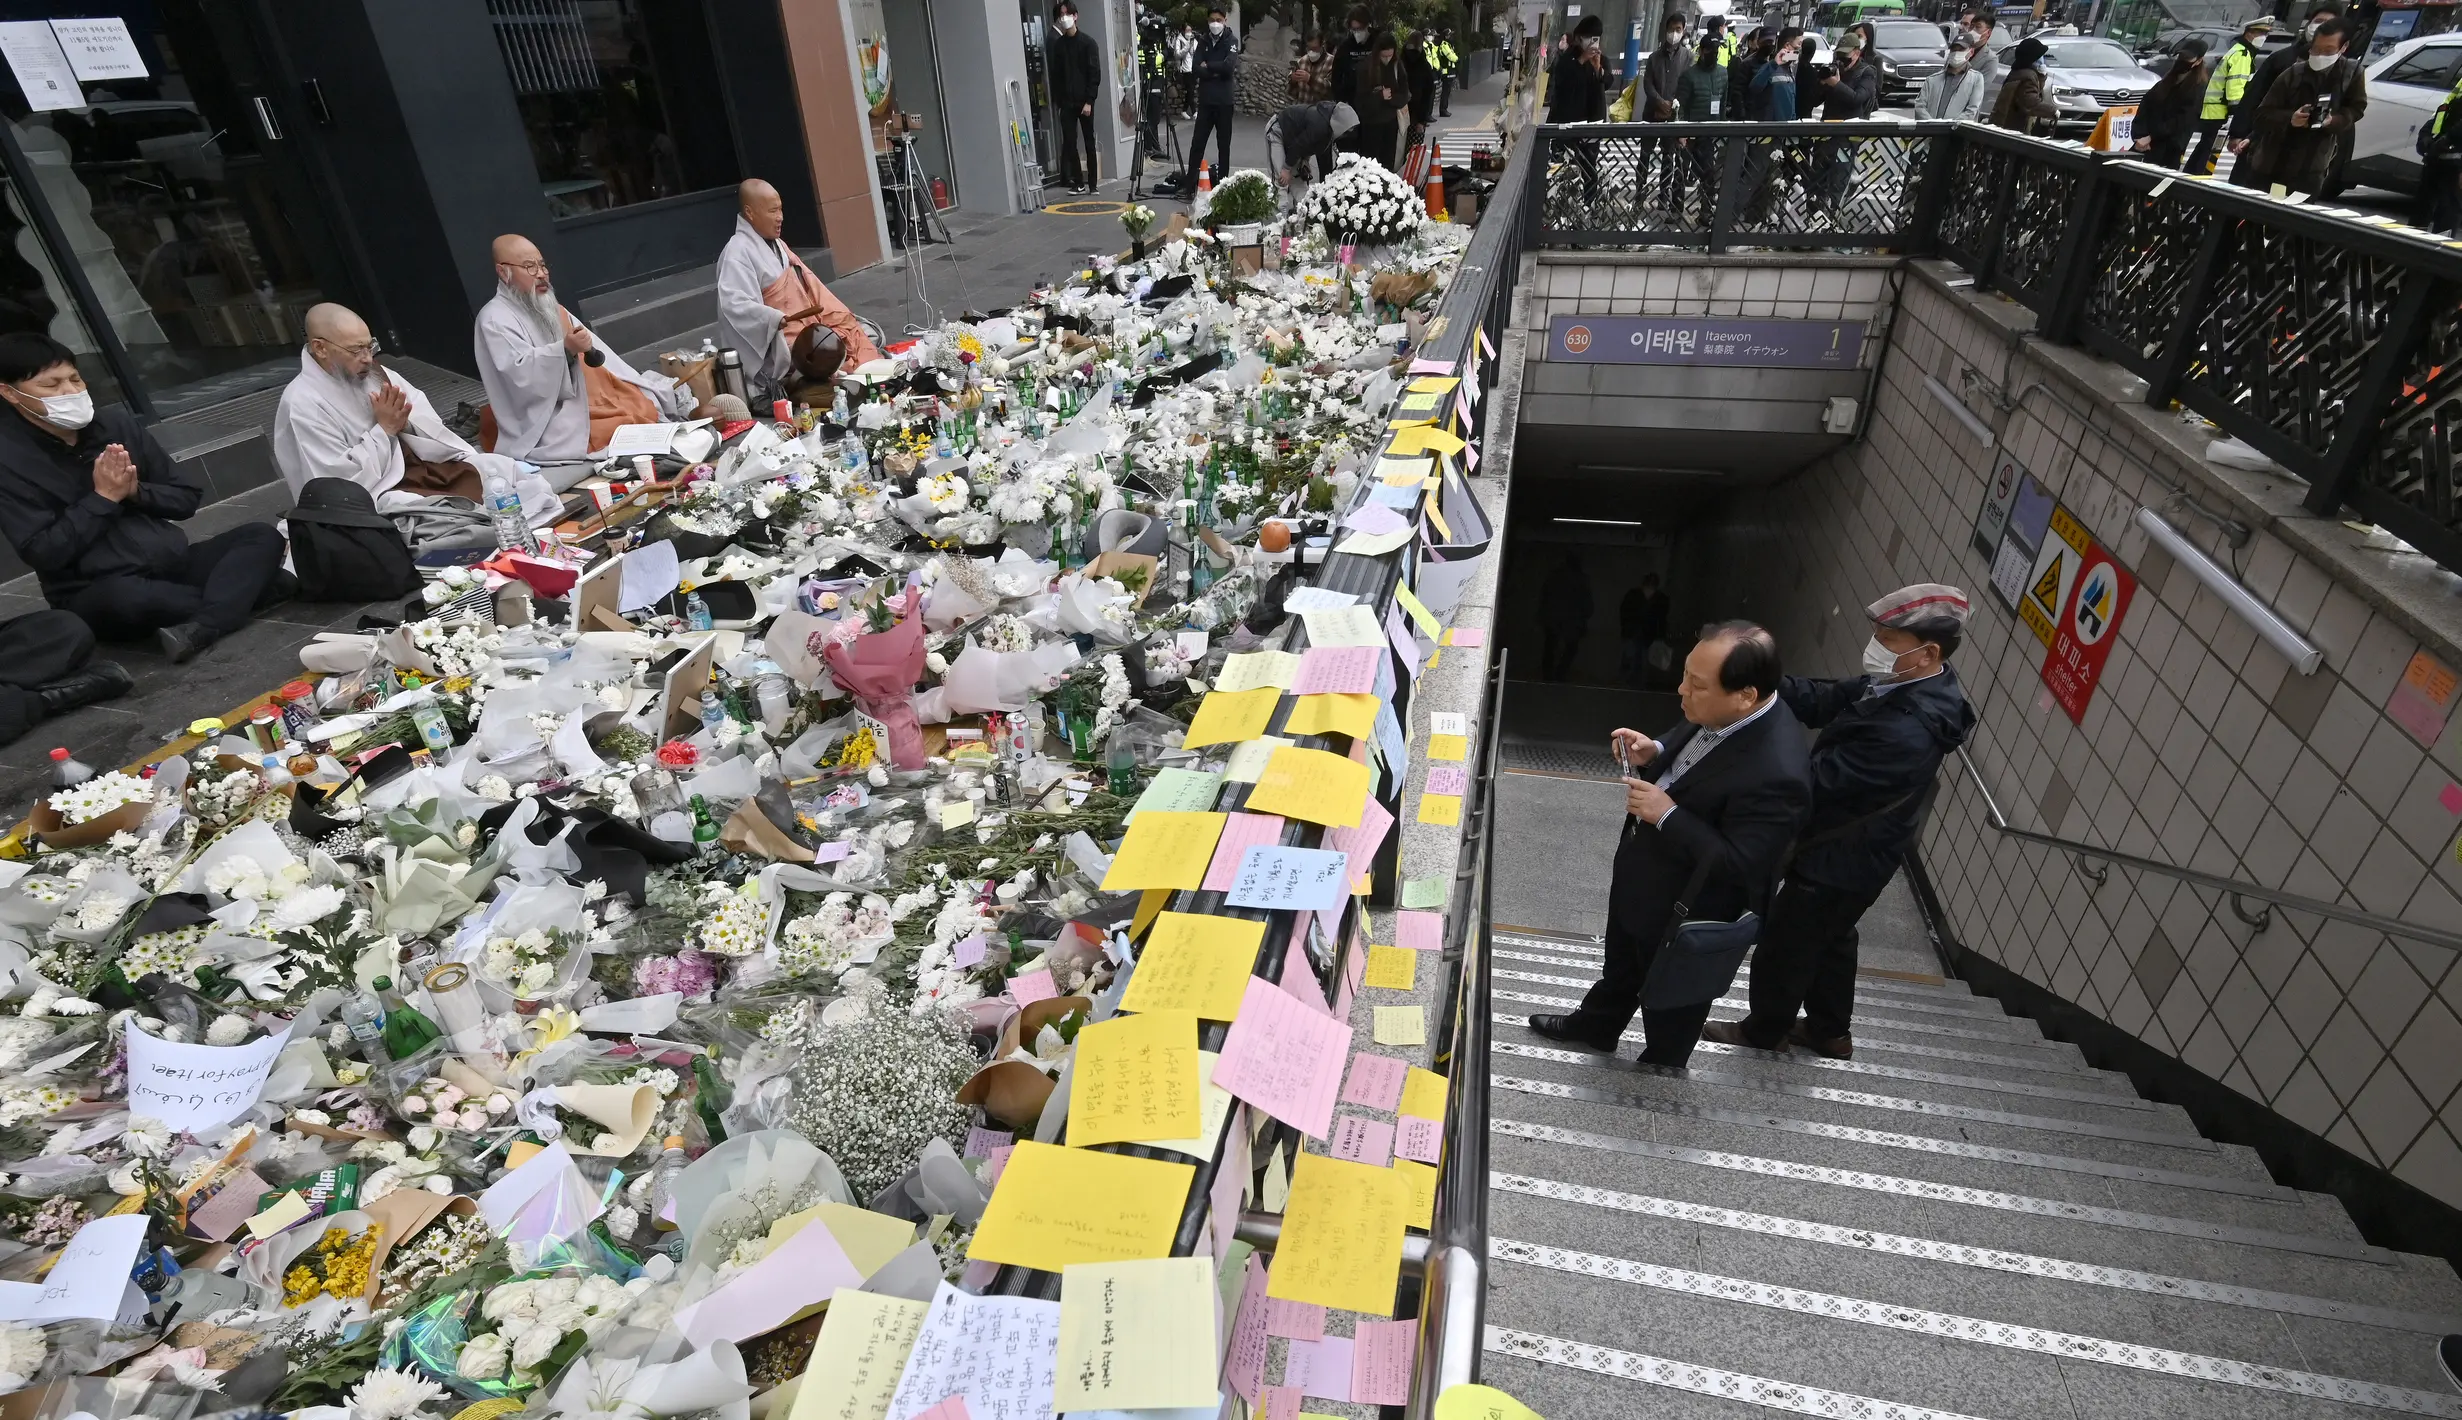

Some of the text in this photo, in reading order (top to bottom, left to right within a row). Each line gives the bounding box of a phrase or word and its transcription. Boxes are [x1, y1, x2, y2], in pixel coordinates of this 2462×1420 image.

[1567, 334, 1588, 345] 630
[1630, 328, 1697, 355] 이태원
[1705, 330, 1752, 342] Itaewon
[1831, 328, 1840, 349] 1
[1703, 345, 1735, 355] 梨泰院
[1744, 346, 1789, 356] イテウォン
[2056, 632, 2092, 684] 대피소
[2054, 662, 2079, 695] shelter
